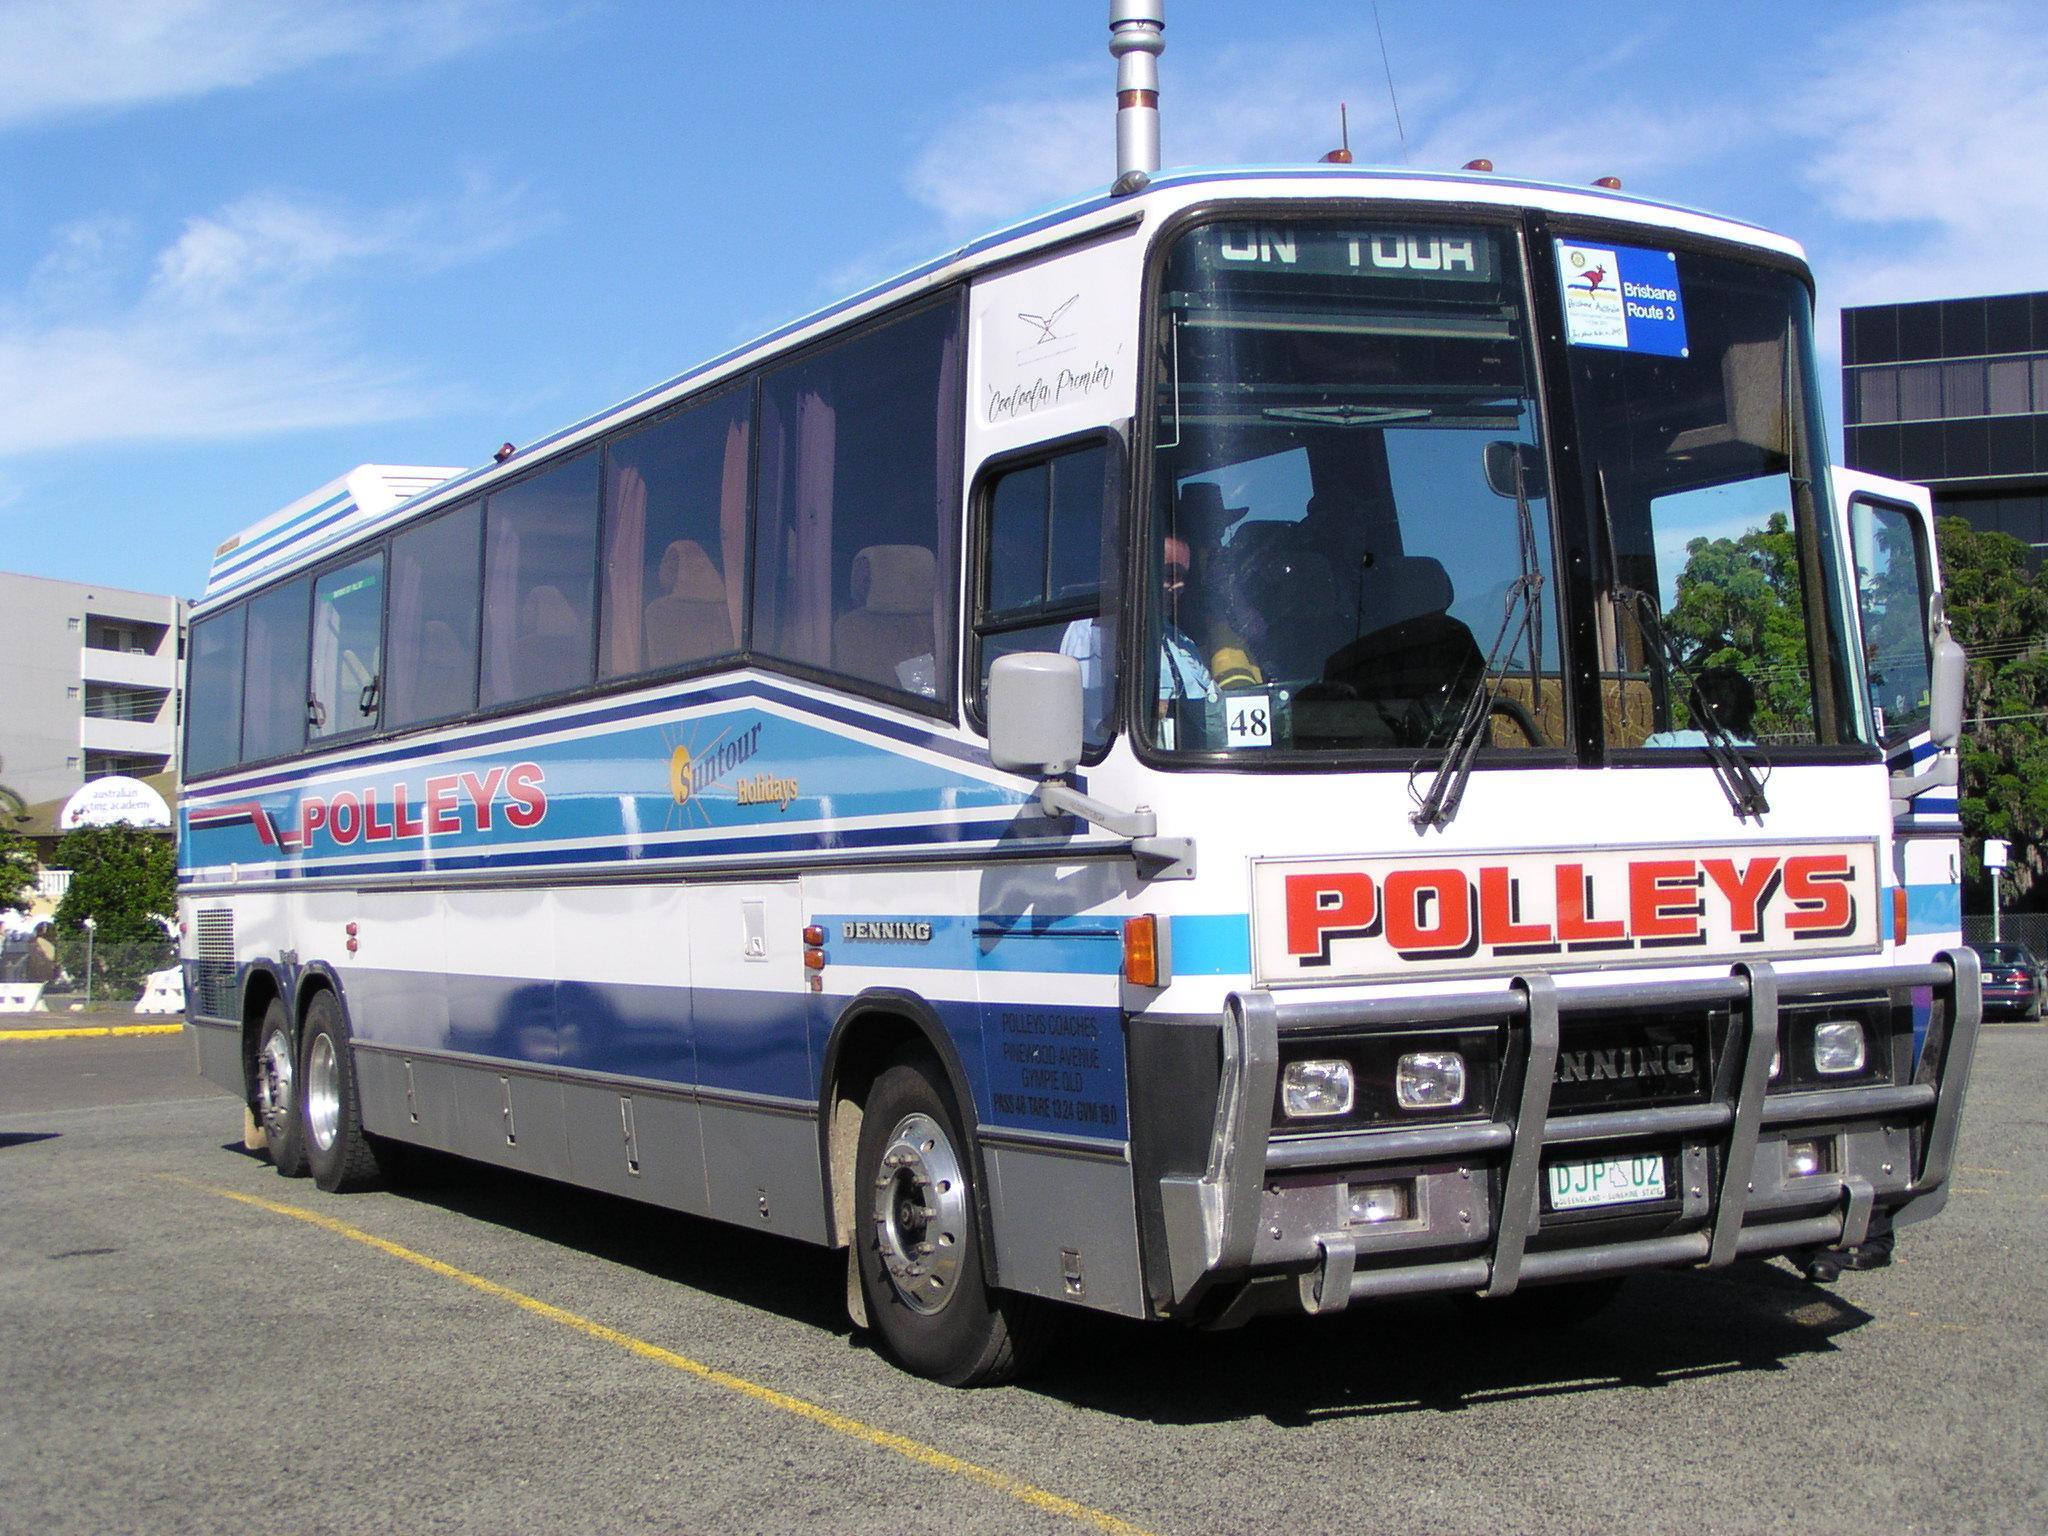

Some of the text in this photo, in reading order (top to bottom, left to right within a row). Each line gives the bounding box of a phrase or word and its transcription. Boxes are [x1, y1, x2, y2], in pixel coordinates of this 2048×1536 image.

[1221, 228, 1474, 271] ON TOUR
[1623, 282, 1677, 302] Brisbane
[1626, 302, 1664, 320] Route
[1665, 305, 1676, 321] 3
[1230, 708, 1267, 737] 48
[680, 721, 762, 803] Suntour
[301, 761, 548, 849] POLLEYS
[736, 772, 798, 812] Holidays
[1285, 854, 1857, 968] POLLEYS
[843, 921, 932, 941] DENNING
[1002, 1013, 1098, 1038] POLLEYS COACHES
[1059, 1046, 1100, 1069] AVENUE
[1552, 1043, 1694, 1084] NNING
[1021, 1068, 1084, 1093] GYMPIE QLD
[993, 1093, 1015, 1114] PASS
[1028, 1096, 1051, 1118] TARE
[1556, 1153, 1660, 1195] DJP 02
